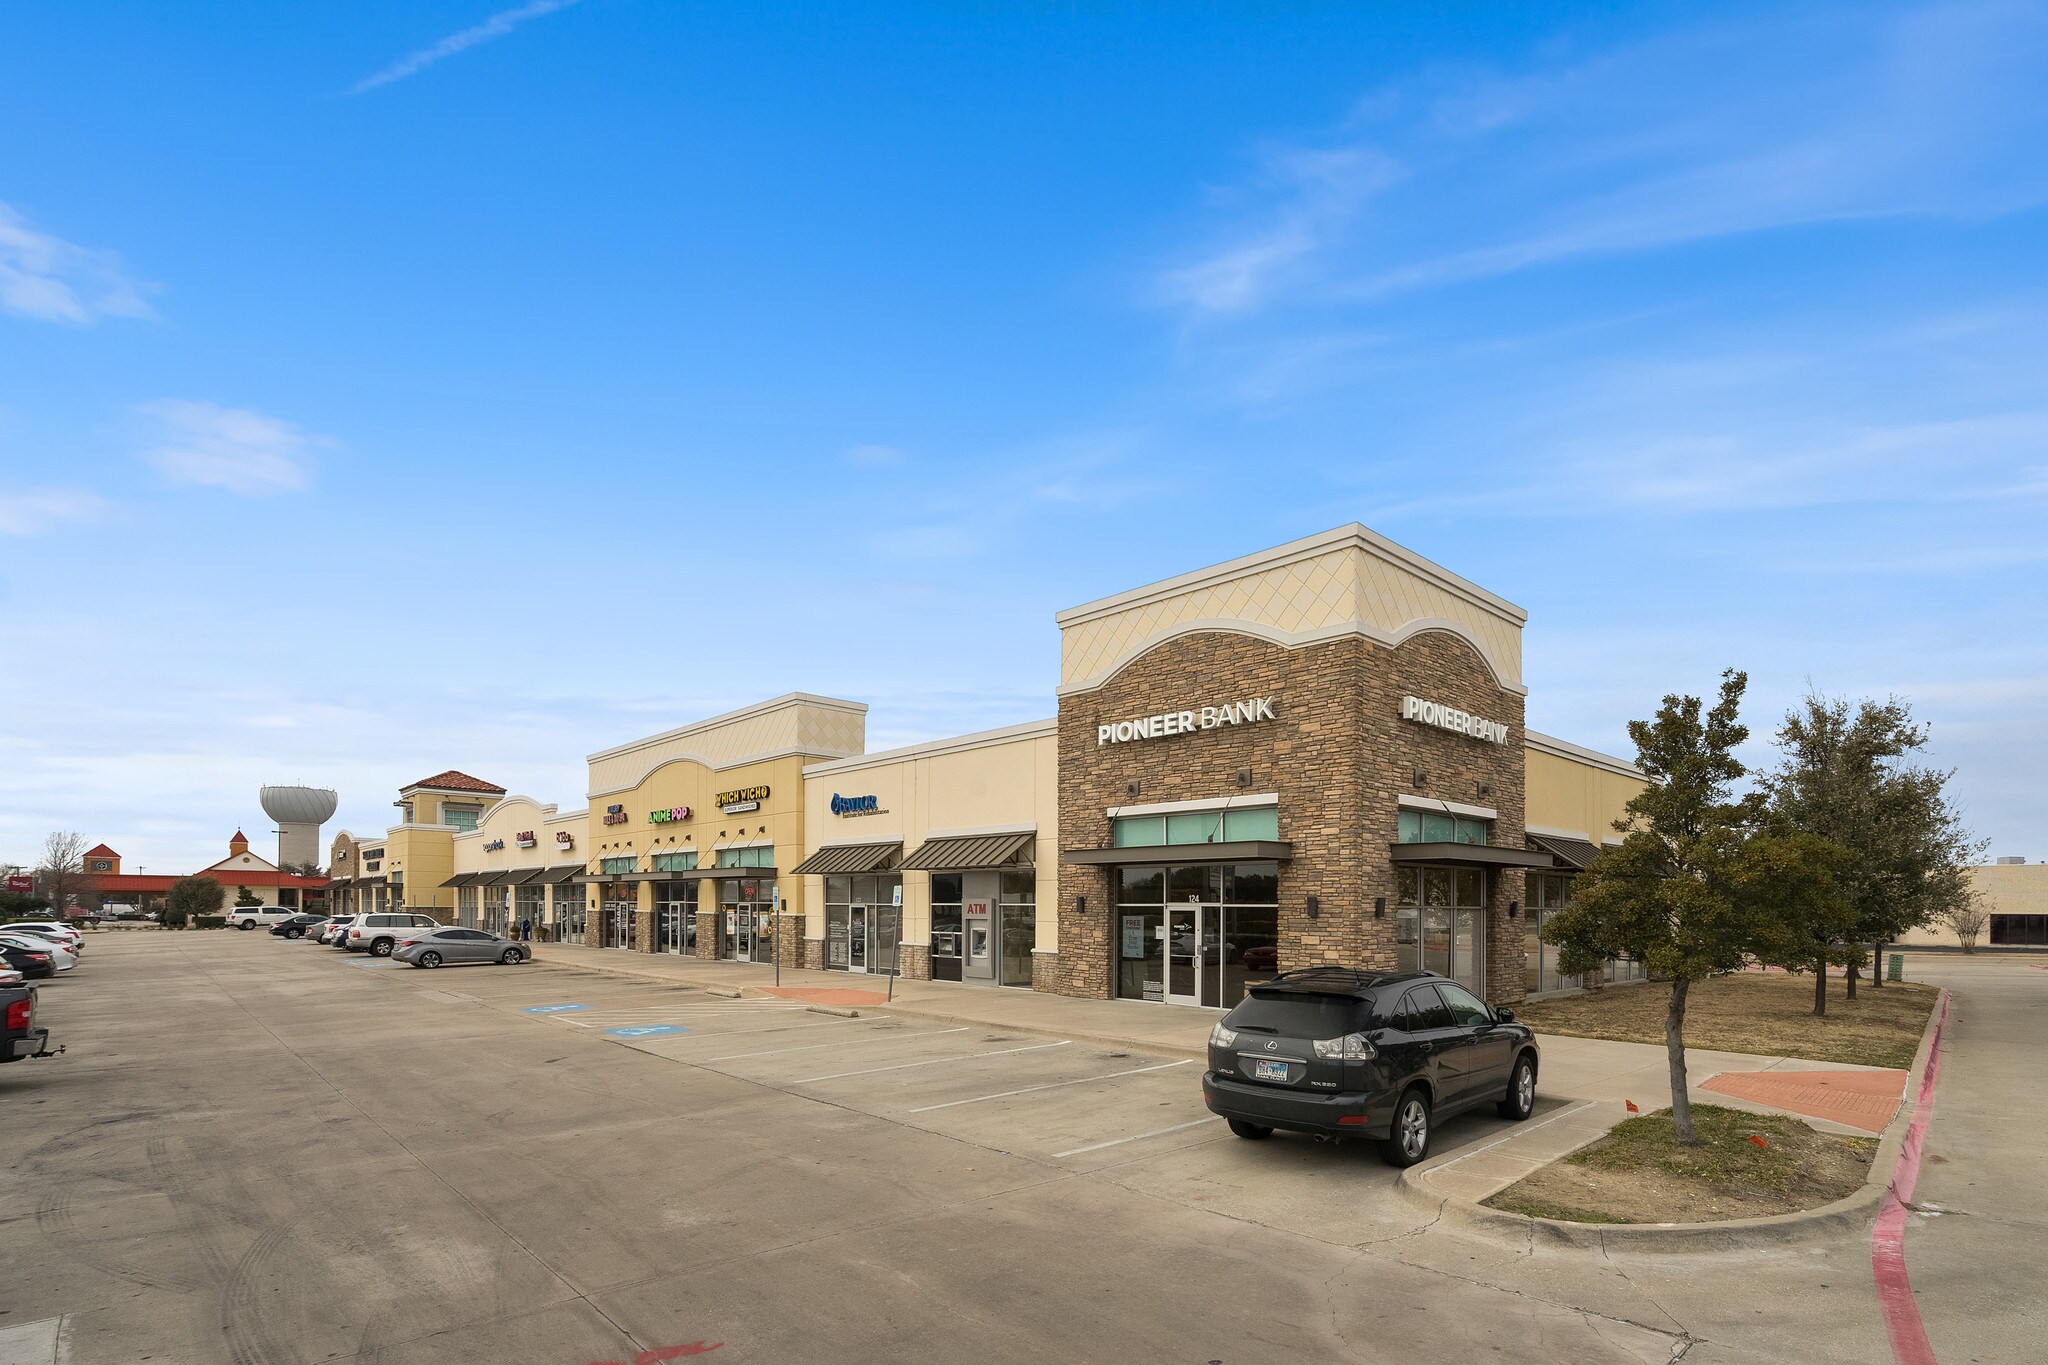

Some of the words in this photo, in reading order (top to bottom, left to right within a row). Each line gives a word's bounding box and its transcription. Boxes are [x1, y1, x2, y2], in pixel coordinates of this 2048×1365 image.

[1097, 710, 1197, 746] PIONEER
[1200, 695, 1276, 730] BANK
[1403, 695, 1471, 736] PIONEER
[1470, 716, 1509, 746] BANK
[715, 790, 739, 807] WHICH
[839, 795, 878, 812] BAYLOR
[648, 808, 671, 824] ANIME
[671, 806, 689, 821] POP
[1188, 894, 1200, 903] 124
[967, 903, 987, 915] ATM
[1126, 919, 1141, 927] FREE
